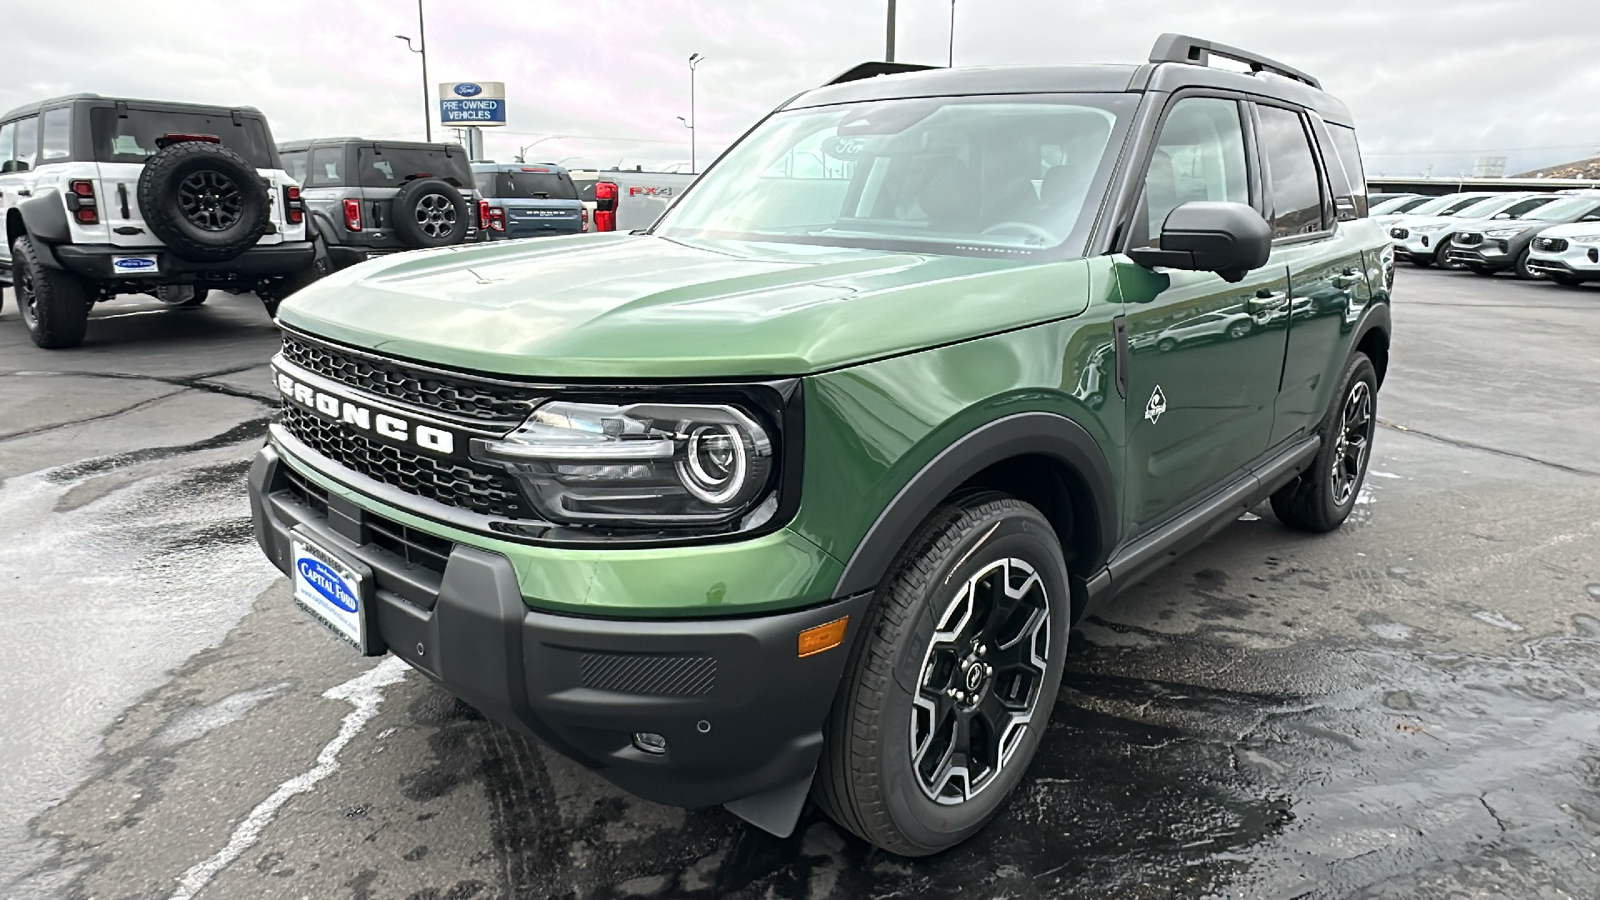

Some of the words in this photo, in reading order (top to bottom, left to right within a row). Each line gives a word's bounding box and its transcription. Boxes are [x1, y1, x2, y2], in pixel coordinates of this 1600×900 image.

[443, 101, 497, 110] PRE-OWNED
[448, 111, 491, 120] VEHICLES
[836, 138, 864, 153] For
[629, 186, 673, 197] FX4
[278, 373, 453, 454] BRONCO
[301, 562, 334, 594] CAPITAL
[335, 583, 356, 610] FORD
